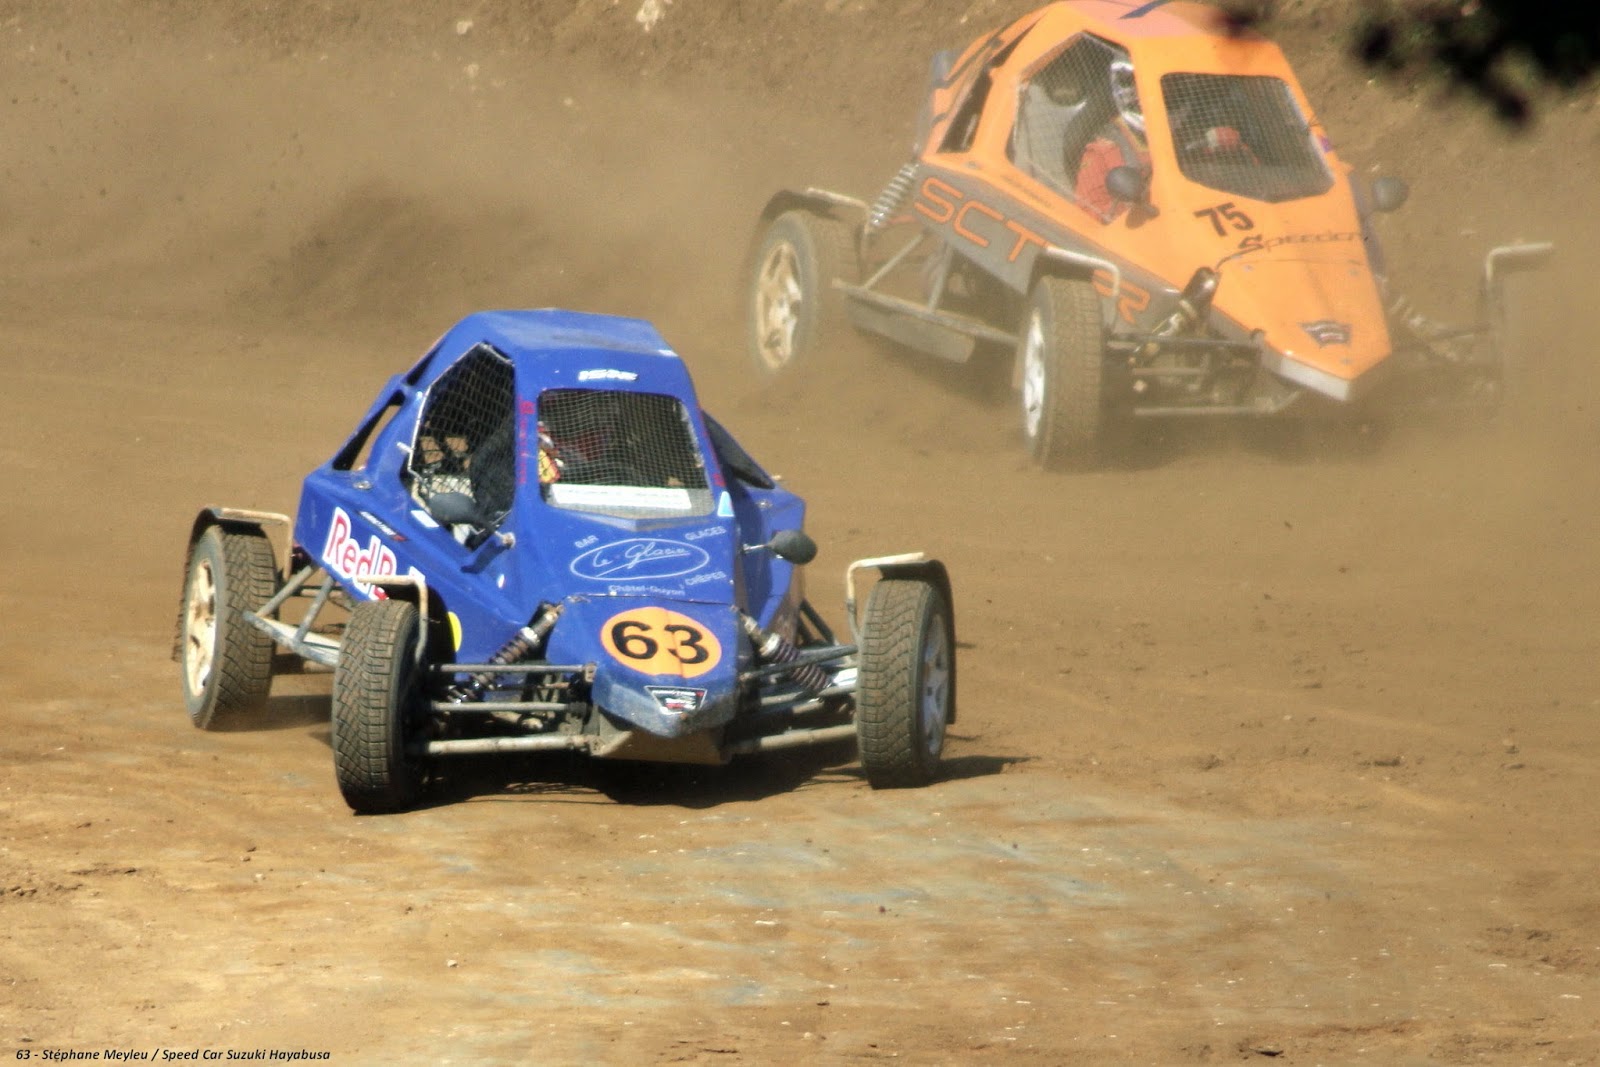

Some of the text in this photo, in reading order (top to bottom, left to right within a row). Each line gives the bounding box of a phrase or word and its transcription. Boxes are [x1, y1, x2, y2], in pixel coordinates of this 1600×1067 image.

[914, 177, 1048, 262] SCT
[1193, 202, 1254, 237] 75
[574, 535, 599, 548] BAR
[684, 525, 727, 541] GLACES
[611, 621, 710, 665] 63
